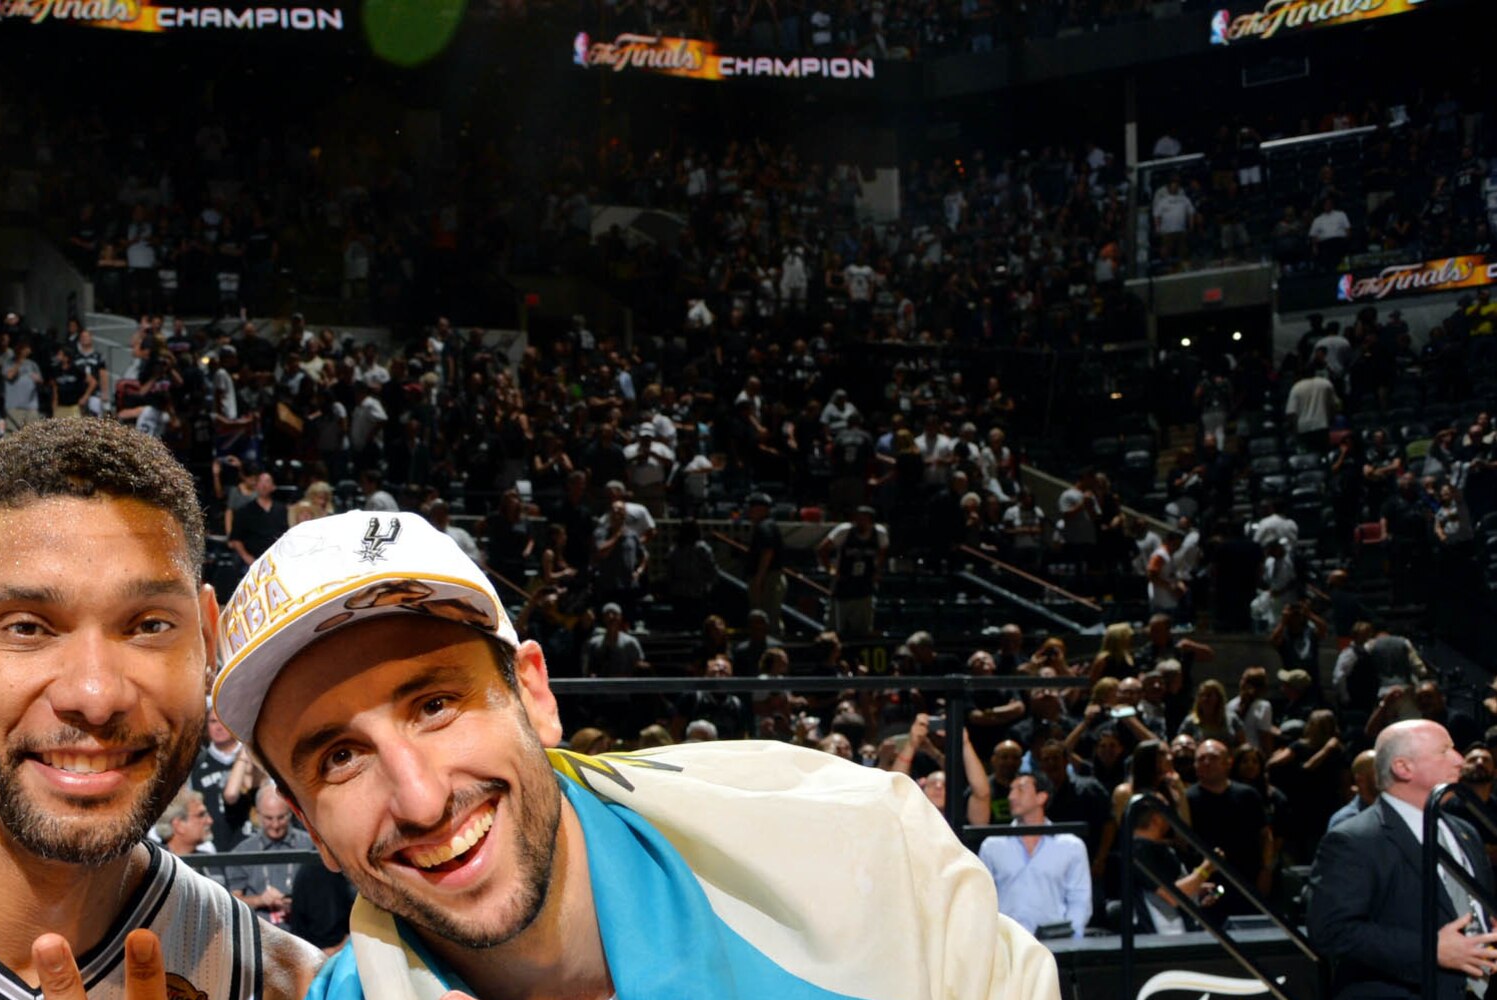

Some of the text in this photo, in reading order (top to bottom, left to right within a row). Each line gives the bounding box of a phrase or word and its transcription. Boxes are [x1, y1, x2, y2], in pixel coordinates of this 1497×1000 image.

[155, 7, 343, 30] CHAMPION
[1228, 0, 1382, 40] The Finals
[613, 33, 702, 72] Finals
[717, 56, 875, 78] CHAMPION
[1376, 257, 1474, 299] Finals
[227, 576, 293, 654] NBA
